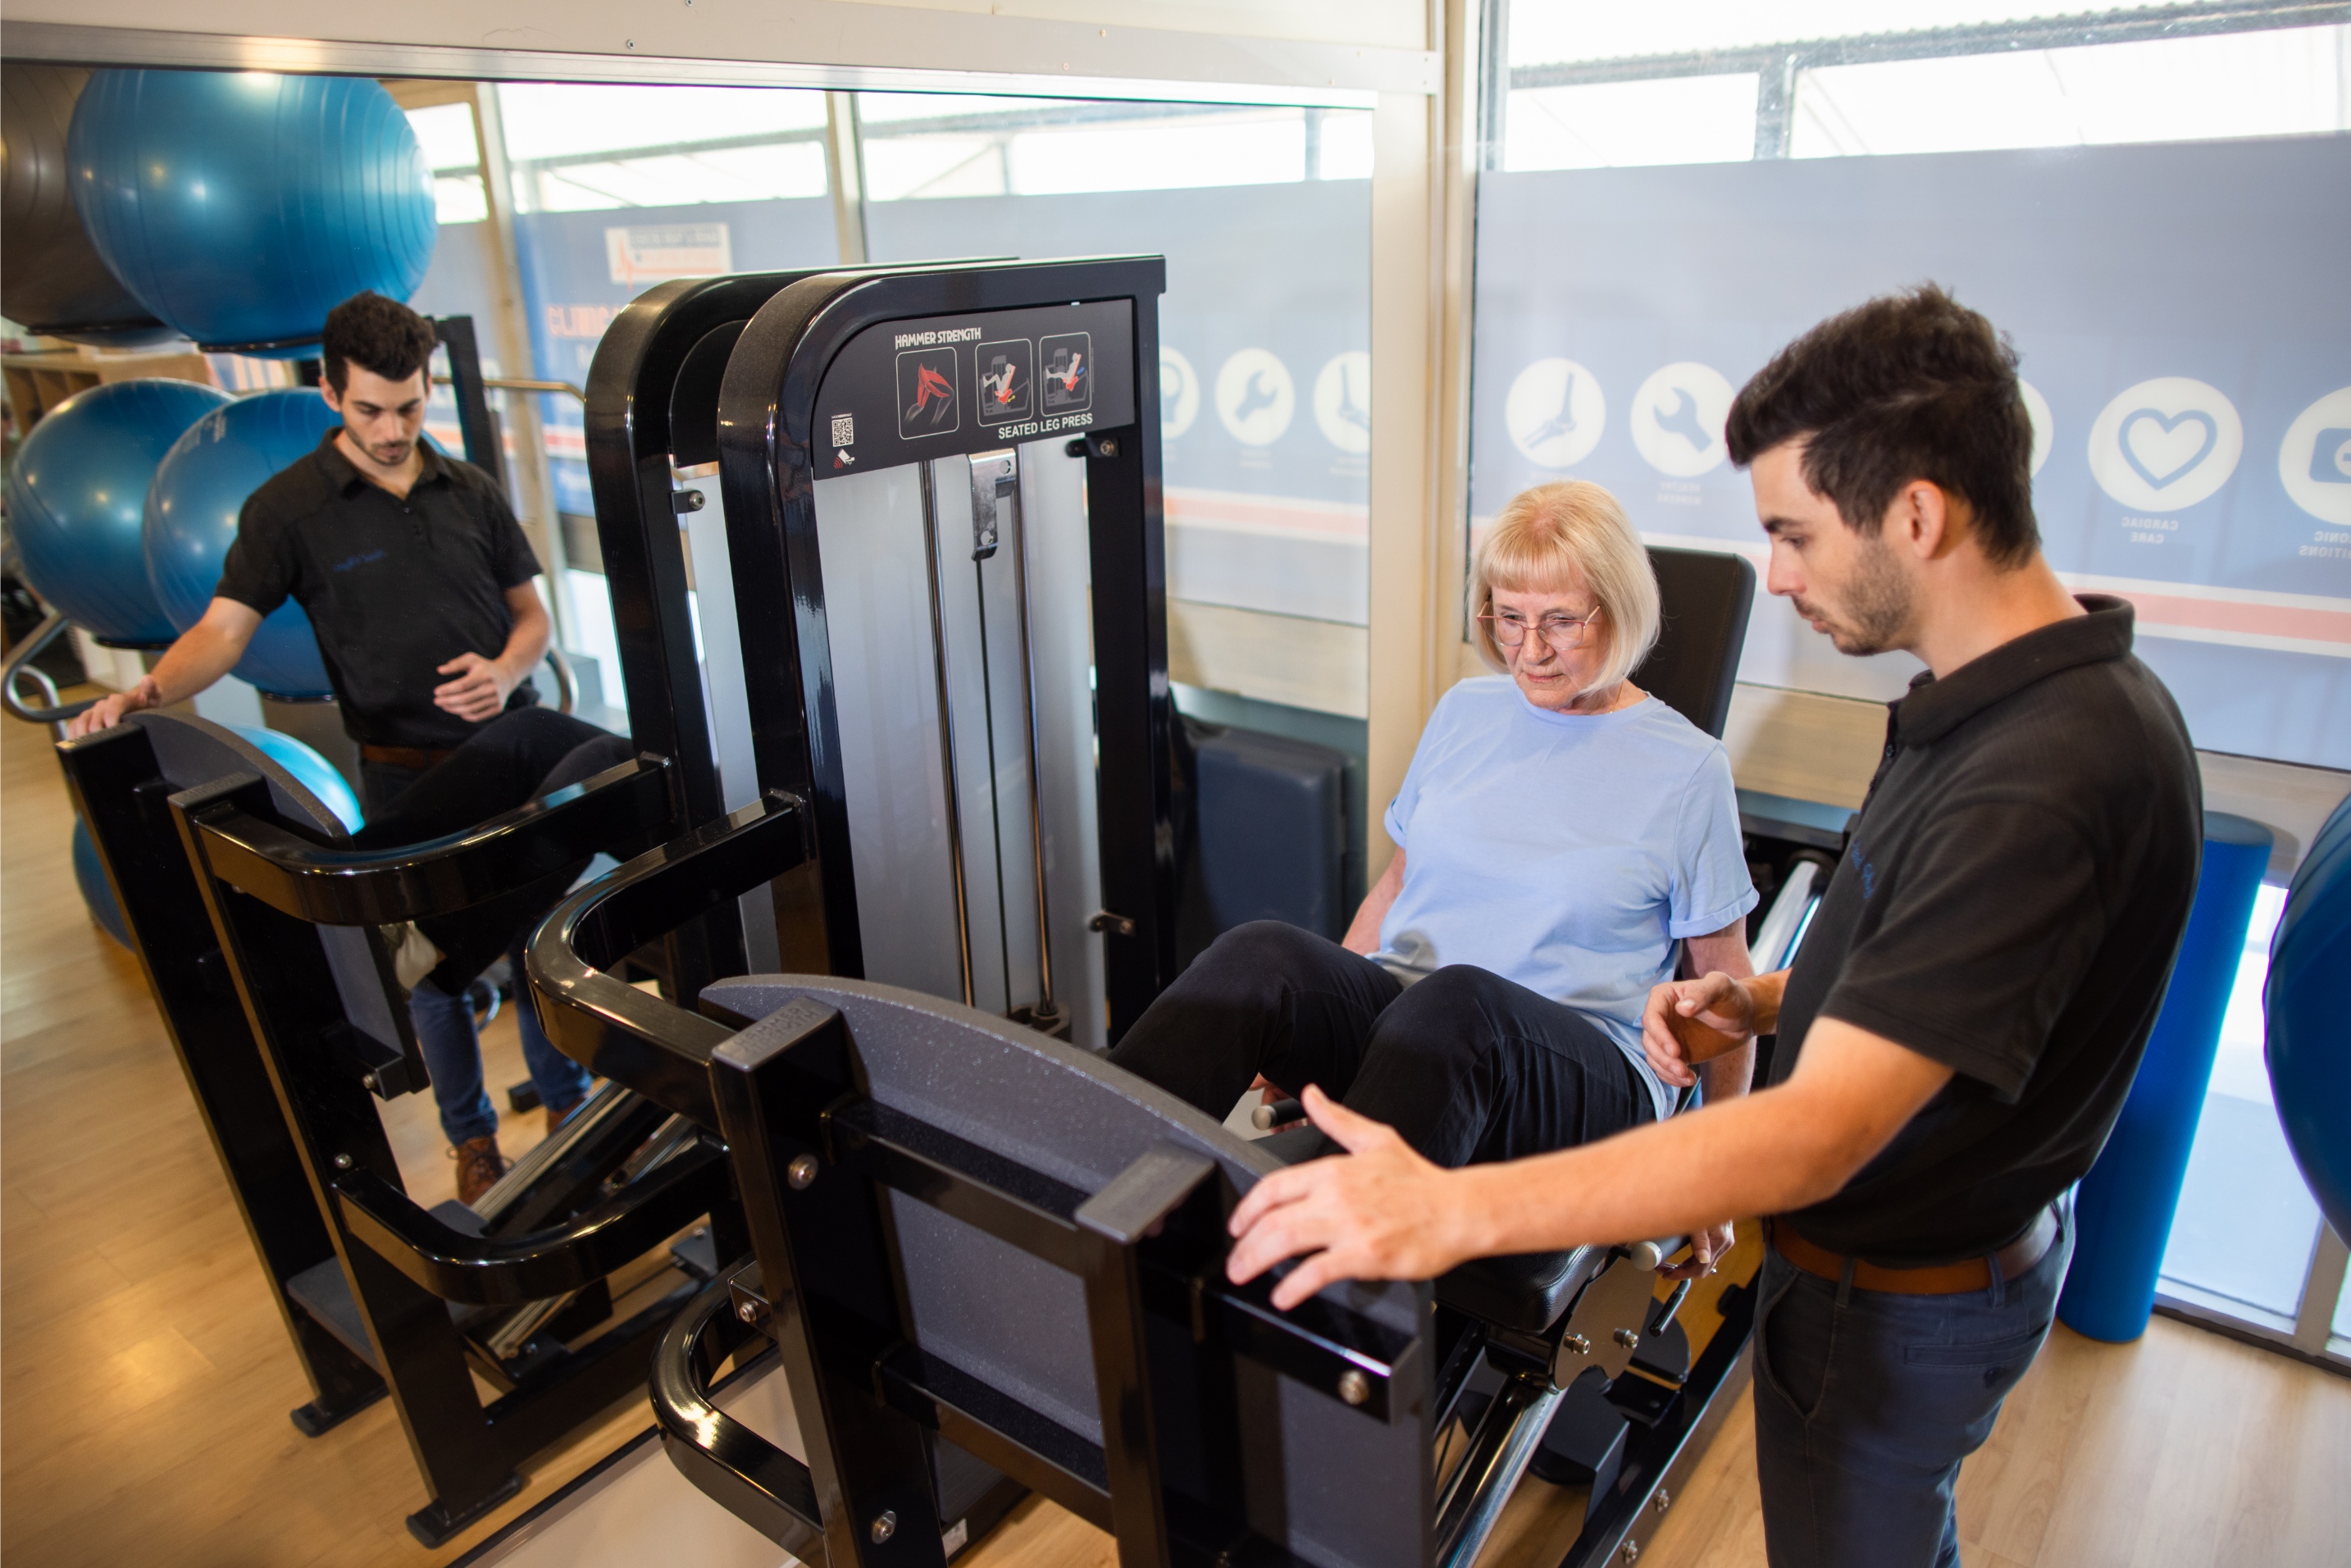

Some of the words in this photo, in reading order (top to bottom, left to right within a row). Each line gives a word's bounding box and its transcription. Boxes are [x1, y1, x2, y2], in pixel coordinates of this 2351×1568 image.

[895, 331, 936, 350] HAMMER
[937, 327, 982, 344] STRENGTH
[998, 422, 1038, 440] SEATED
[1040, 418, 1060, 432] LEG
[1062, 413, 1093, 428] PRESS
